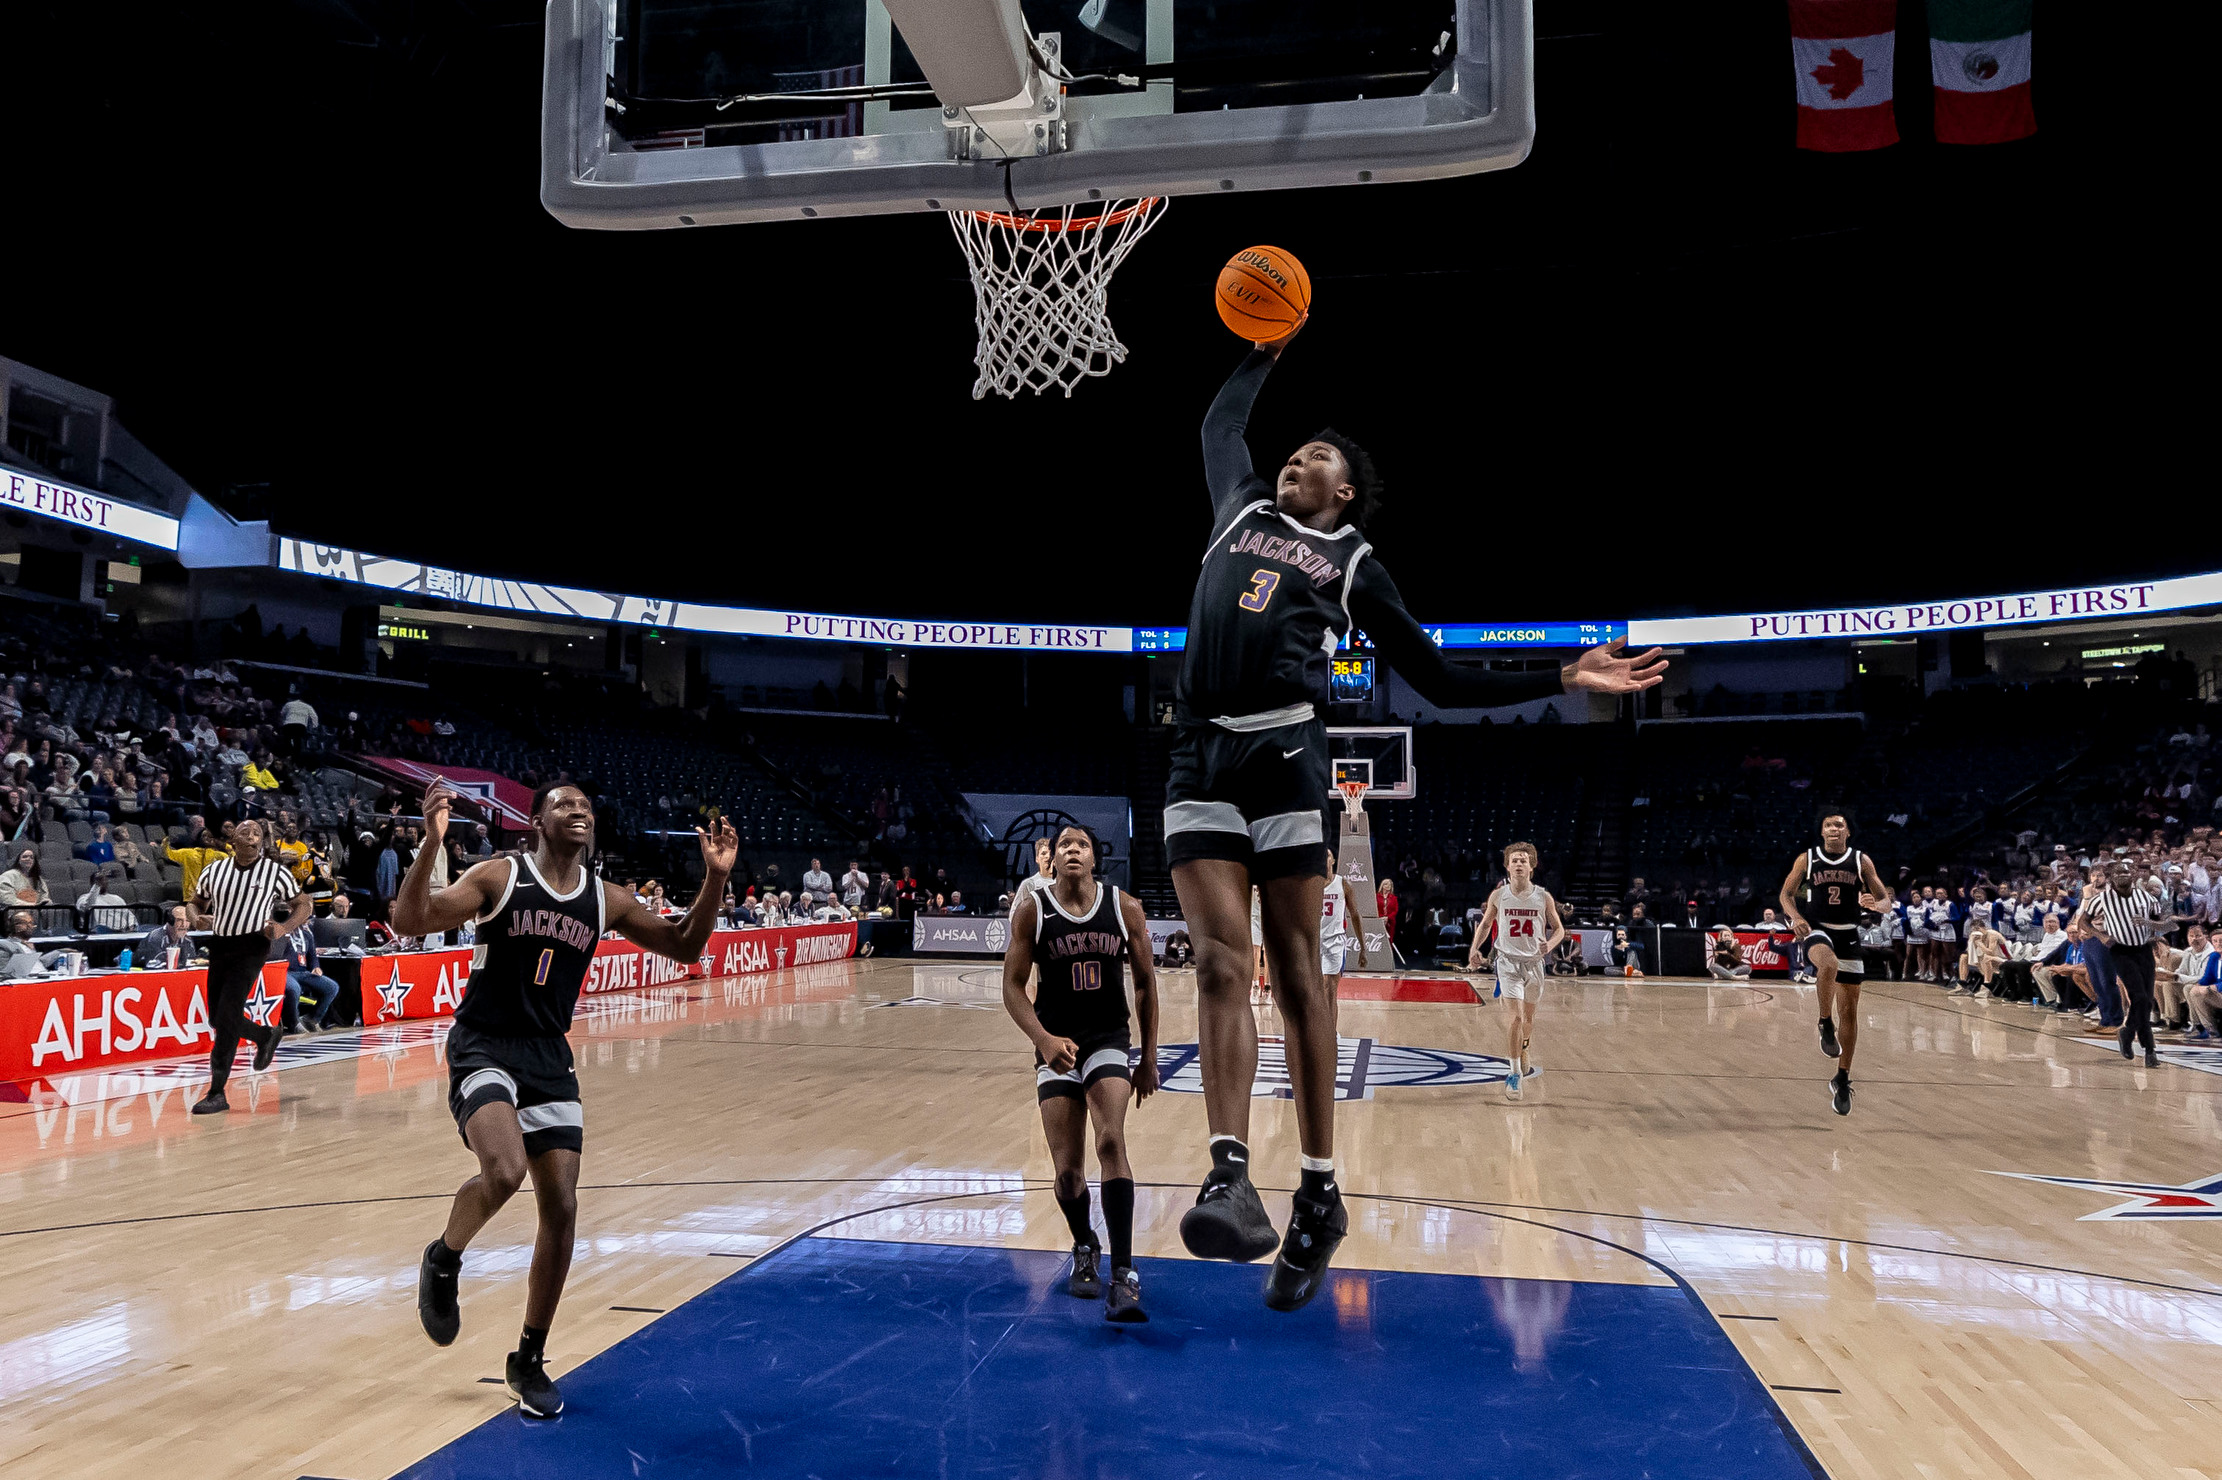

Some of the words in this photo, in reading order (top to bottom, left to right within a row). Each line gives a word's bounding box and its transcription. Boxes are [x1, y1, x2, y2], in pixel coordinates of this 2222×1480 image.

[1237, 251, 1288, 290] Wilson
[34, 482, 113, 527] FIRST
[1229, 529, 1342, 589] JACKSON
[1238, 569, 1281, 613] 3
[1750, 610, 1896, 637] PUTTING
[1906, 596, 2038, 628] PEOPLE
[2048, 584, 2155, 617] FIRST
[389, 626, 430, 640] GRILL
[785, 614, 905, 642] PUTTING
[913, 624, 1021, 646] PEOPLE
[1028, 627, 1108, 649] FIRST
[1480, 629, 1546, 642] JACKSON
[1580, 624, 1599, 632] TOL
[1605, 624, 1613, 633] 2
[1580, 636, 1598, 645] FLS
[1333, 661, 1362, 675] 36.8
[1813, 870, 1858, 886] JACKSON
[1828, 886, 1841, 905] 2
[507, 909, 595, 953] JACKSON
[933, 929, 978, 942] AHSAA
[1509, 918, 1534, 938] 24
[723, 940, 770, 975] AHSAA
[793, 933, 852, 966] BIRMINGHAM
[1047, 931, 1122, 961] JACKSON
[533, 948, 554, 986] 1
[586, 953, 639, 993] STATE
[1072, 961, 1102, 991] 10
[31, 984, 216, 1067] AHSAA
